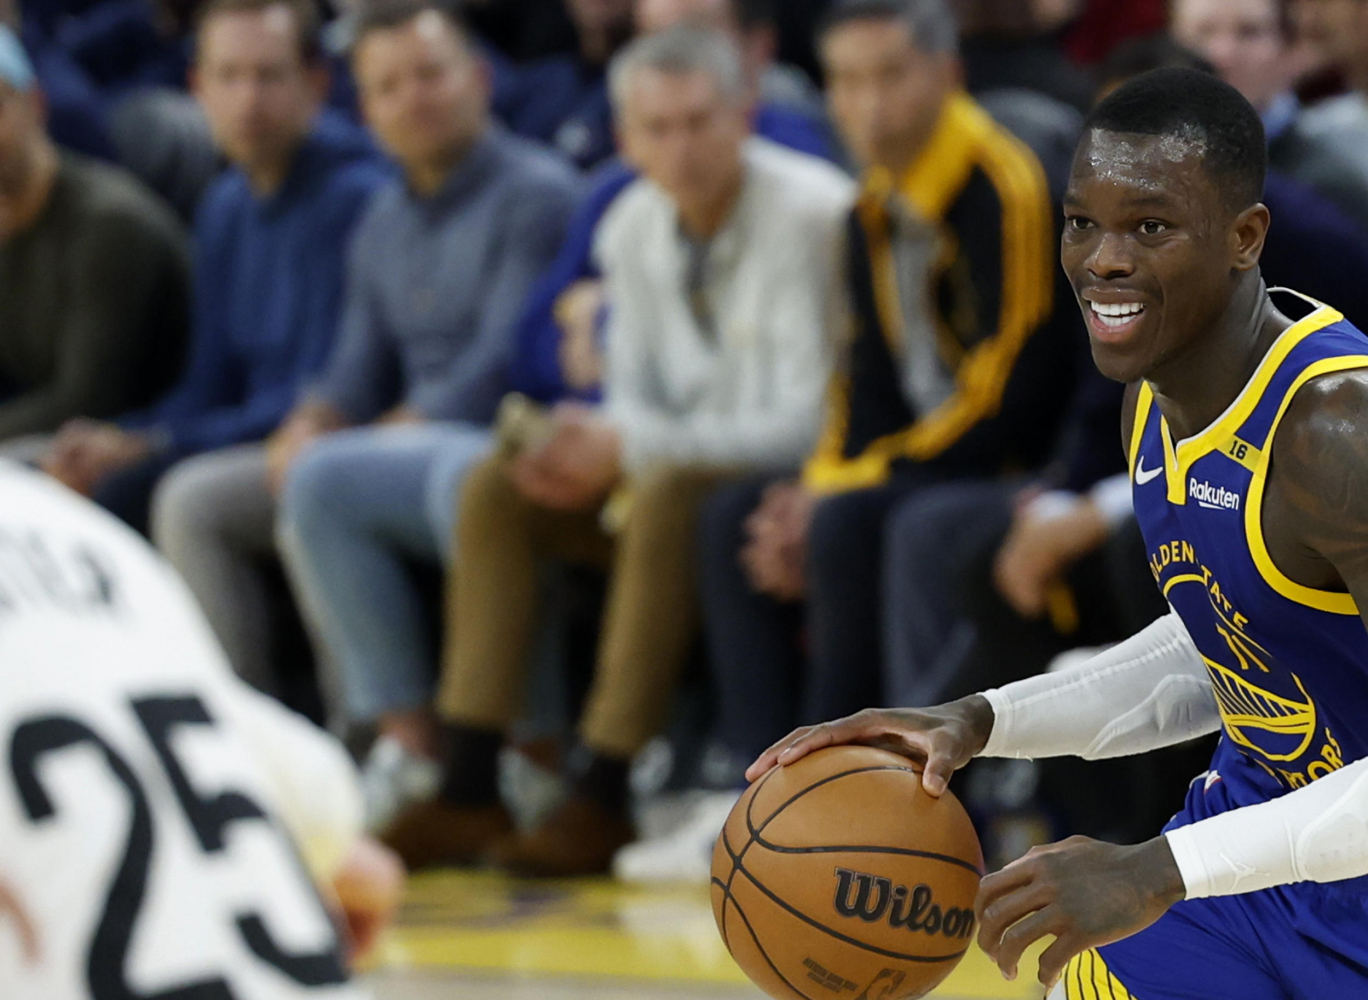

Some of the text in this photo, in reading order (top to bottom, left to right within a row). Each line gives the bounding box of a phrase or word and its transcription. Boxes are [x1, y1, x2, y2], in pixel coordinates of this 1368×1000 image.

[1229, 440, 1248, 460] 16
[1189, 477, 1240, 510] Rakuten
[1150, 540, 1249, 631] OLDEN TATE
[833, 866, 975, 939] Wilson
